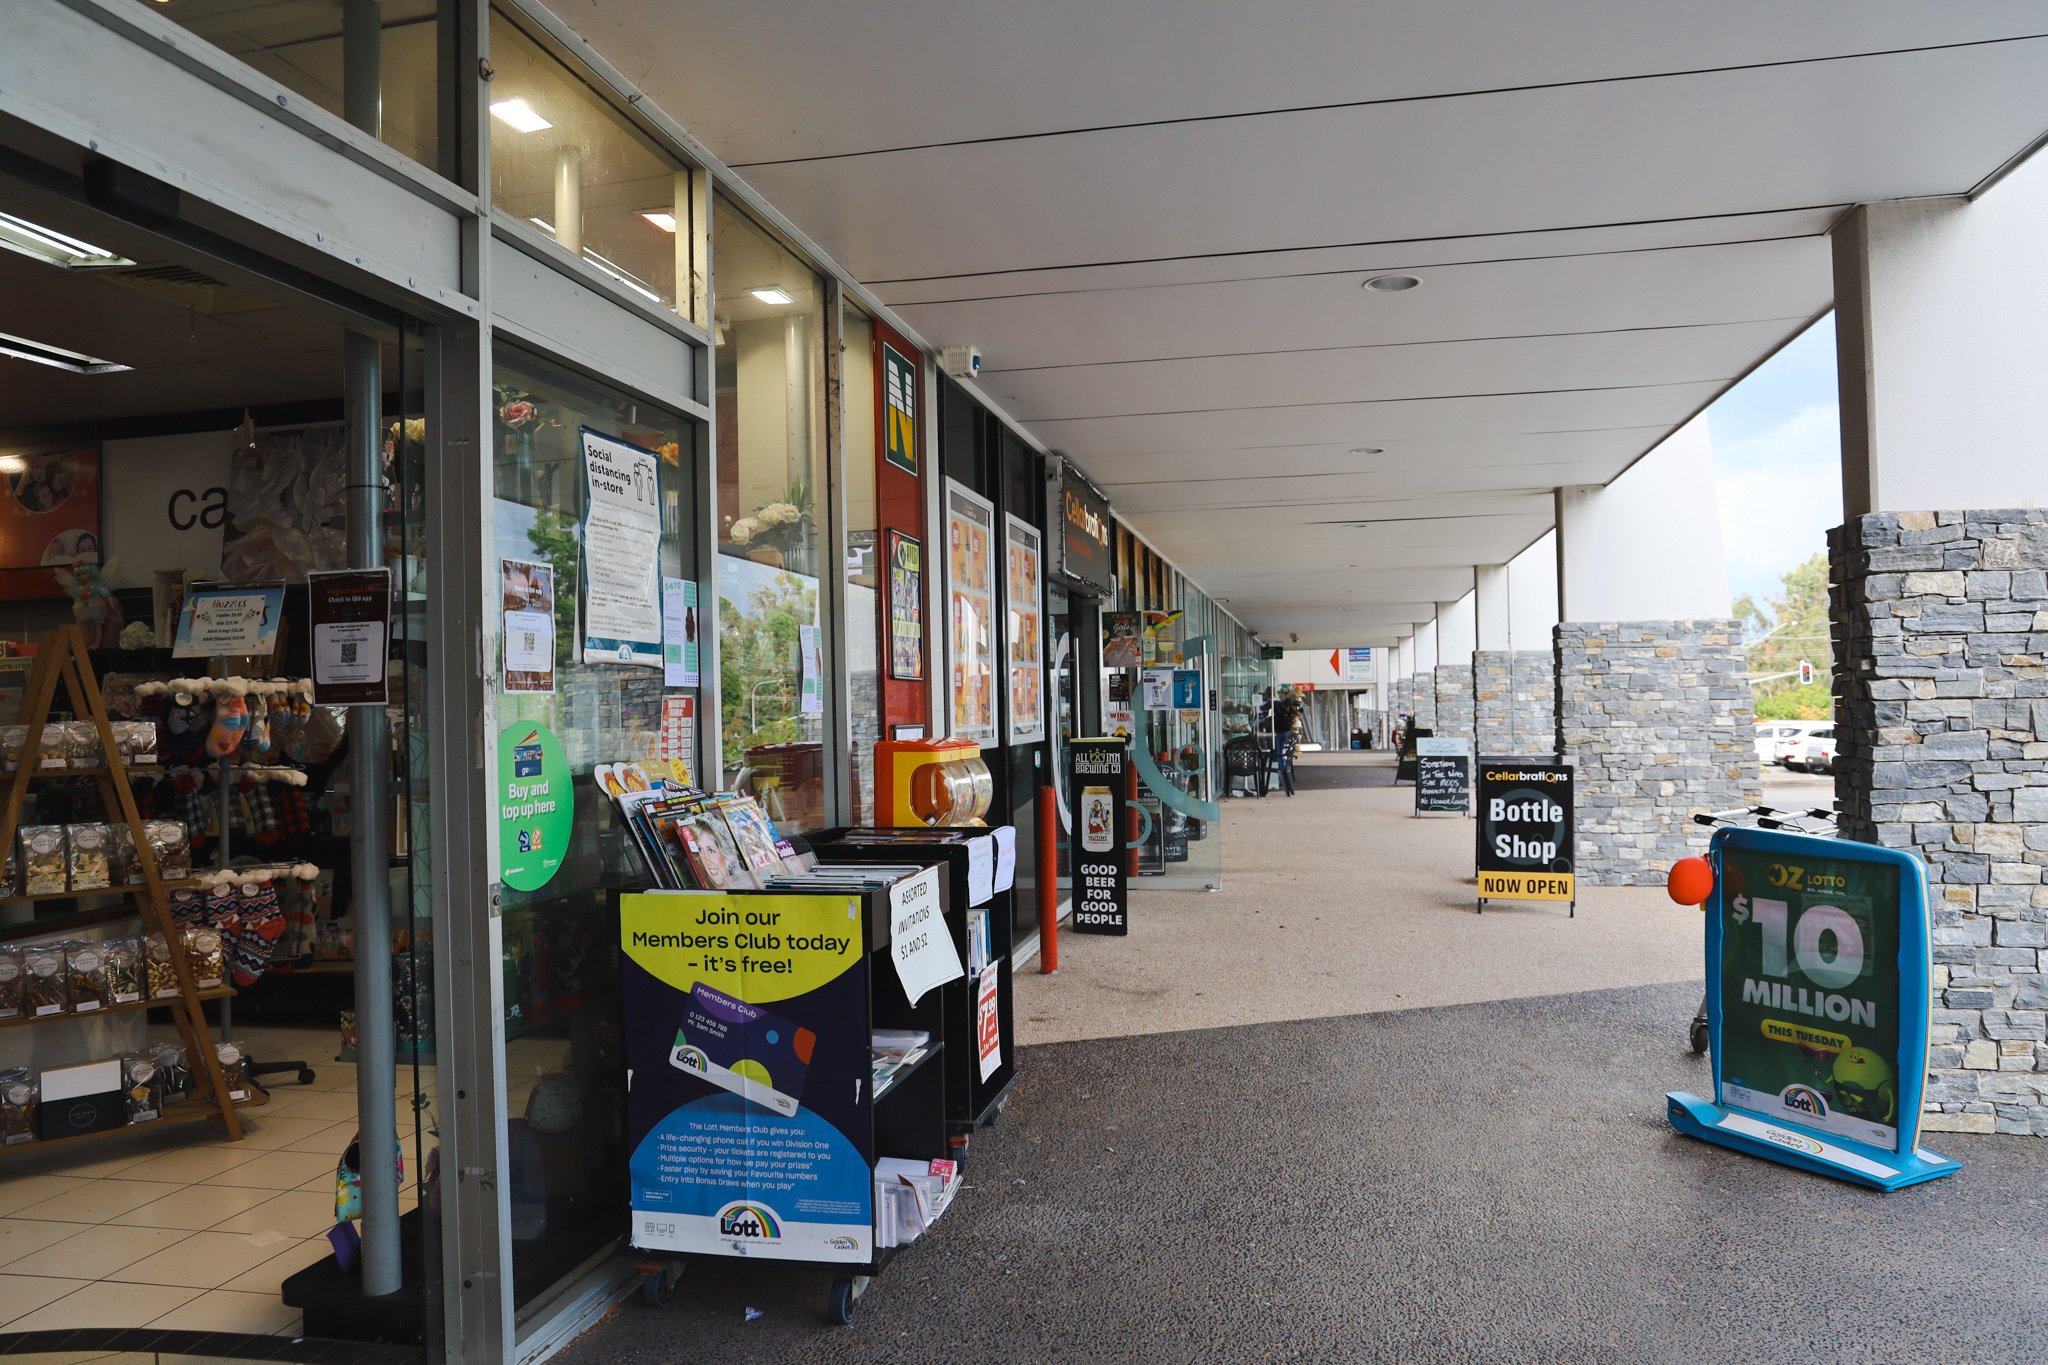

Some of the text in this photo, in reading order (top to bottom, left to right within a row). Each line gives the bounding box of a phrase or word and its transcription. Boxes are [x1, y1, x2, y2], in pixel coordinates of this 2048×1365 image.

[888, 359, 914, 463] N
[588, 445, 612, 463] Social
[590, 461, 631, 486] distancing
[591, 475, 624, 495] in-store
[1113, 623, 1130, 634] Girls
[1075, 753, 1120, 762] ALL INN
[1075, 764, 1121, 774] BREWING CO
[1486, 771, 1568, 782] Cellarbrations
[509, 780, 549, 801] Buy and
[502, 800, 556, 821] top up here
[1490, 798, 1564, 822] Bottle
[1495, 834, 1557, 864] Shop
[1081, 864, 1117, 875] GOOD
[1767, 863, 1846, 891] OZ LOTTO
[1085, 876, 1116, 887] BEER
[1484, 878, 1568, 895] NOW OPEN
[902, 882, 928, 906] ASSORTED
[1086, 889, 1111, 900] FOR
[1081, 901, 1118, 912] GOOD
[695, 908, 781, 926] Join our
[898, 905, 930, 935] INVITATIONS
[1076, 913, 1123, 925] PEOPLE
[632, 932, 850, 955] Members Club today
[901, 932, 929, 960] $1 AND $2
[741, 956, 793, 974] free!
[696, 987, 757, 1018] Members Club
[1742, 978, 1876, 1028] MILLION
[687, 1018, 725, 1039] Mr. Sam Smith
[695, 1014, 706, 1023] 123
[705, 1017, 717, 1027] 456
[717, 1022, 728, 1033] 789
[1768, 1024, 1845, 1048] THIS TUESDAY
[676, 1050, 698, 1068] Lott
[1784, 1093, 1812, 1112] Lott
[690, 1122, 702, 1130] The
[704, 1123, 718, 1131] Lott
[719, 1124, 751, 1133] Members
[770, 1128, 789, 1136] gives
[1766, 1129, 1803, 1144] Golden
[666, 1133, 712, 1145] life-changing
[713, 1136, 735, 1145] phone
[756, 1140, 770, 1148] you
[785, 1140, 813, 1149] Division
[814, 1141, 830, 1149] One
[660, 1144, 677, 1152] Prize
[678, 1145, 707, 1154] security
[714, 1147, 730, 1156] your
[731, 1147, 755, 1157] tickets
[770, 1150, 807, 1160] registered
[817, 1153, 832, 1161] you
[660, 1154, 687, 1163] Multiple
[688, 1156, 715, 1165] options
[715, 1157, 726, 1165] for
[727, 1158, 741, 1166] how
[755, 1160, 769, 1169] pay
[770, 1161, 786, 1169] your
[660, 1165, 818, 1181] Faster play by saving your Favourite numbers
[661, 1175, 680, 1184] Entry
[681, 1176, 695, 1184] into
[696, 1177, 717, 1185] Bonus
[718, 1178, 740, 1187] Draws
[741, 1180, 761, 1189] when
[761, 1182, 775, 1190] you
[720, 1217, 760, 1237] Lott
